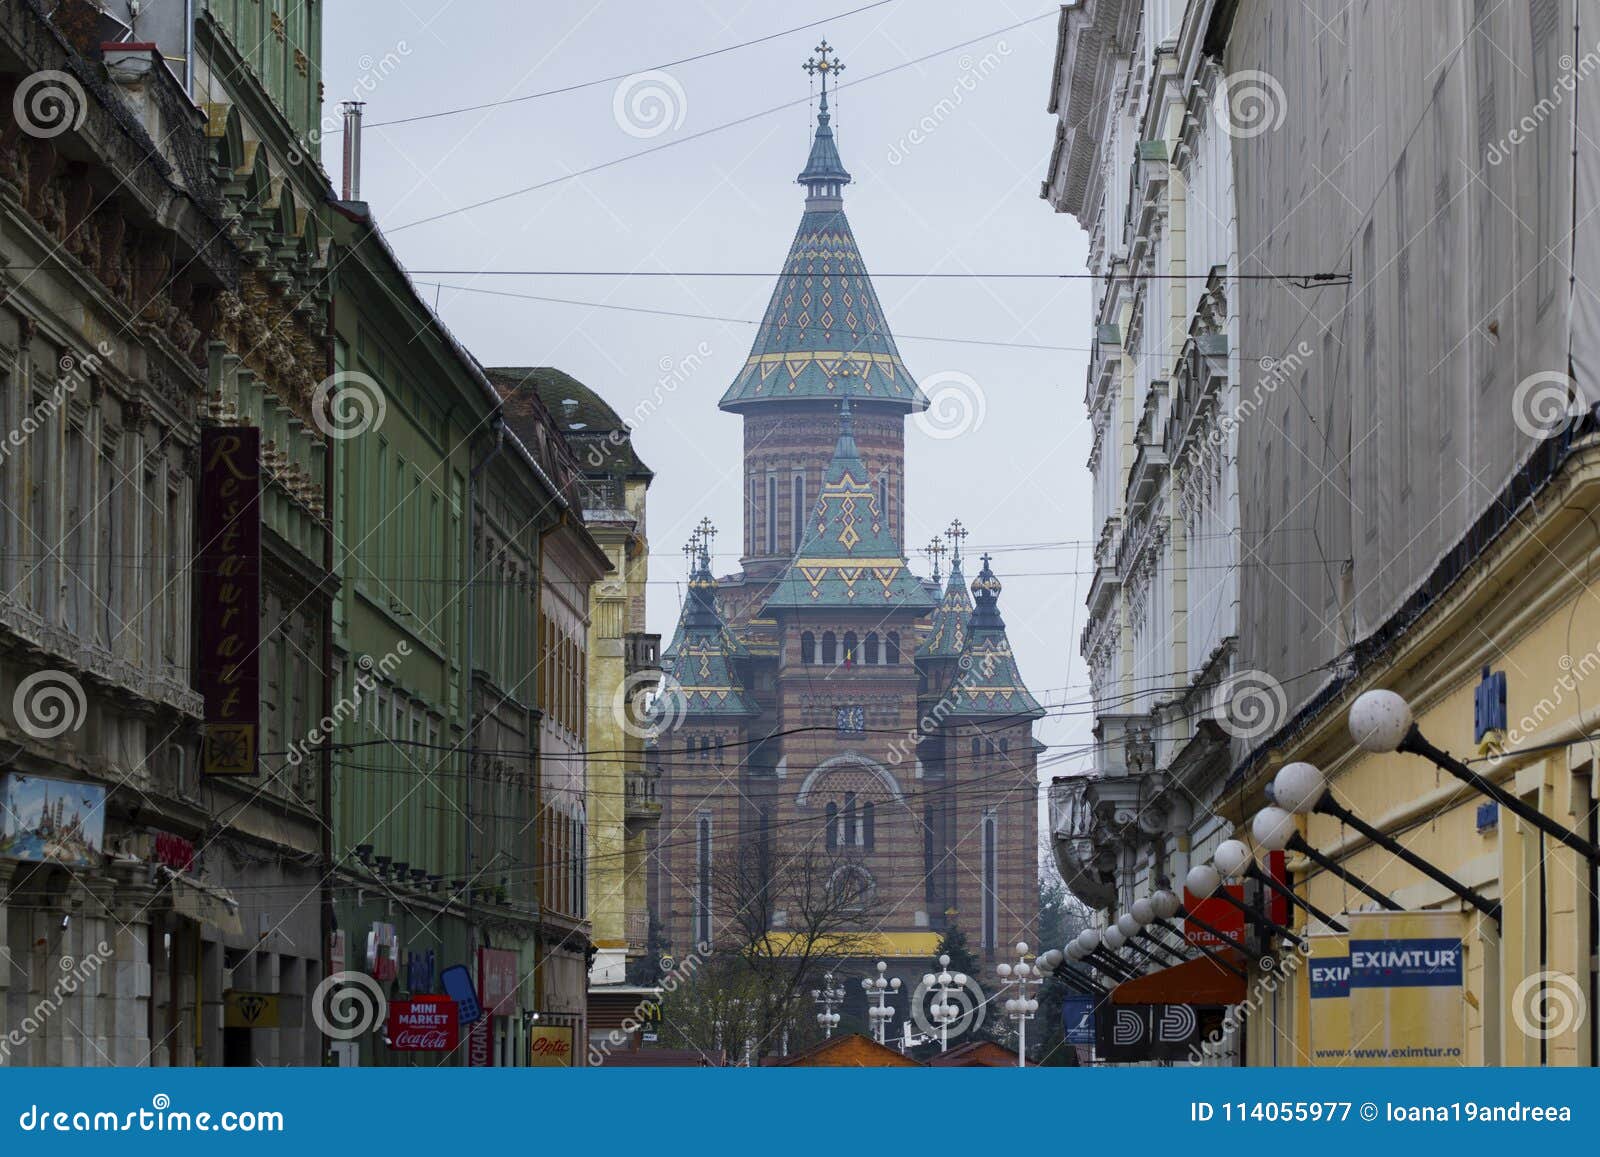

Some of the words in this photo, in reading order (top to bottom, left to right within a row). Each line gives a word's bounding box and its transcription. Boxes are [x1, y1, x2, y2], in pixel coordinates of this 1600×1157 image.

[206, 436, 257, 717] Restaurant
[1351, 950, 1458, 968] EXIMTUR
[410, 1003, 437, 1014] MINI
[399, 1014, 448, 1025] MARKET
[395, 1030, 449, 1049] Coca-Cola
[532, 1037, 570, 1057] Optic
[1354, 1046, 1461, 1059] www.eximtur.ro
